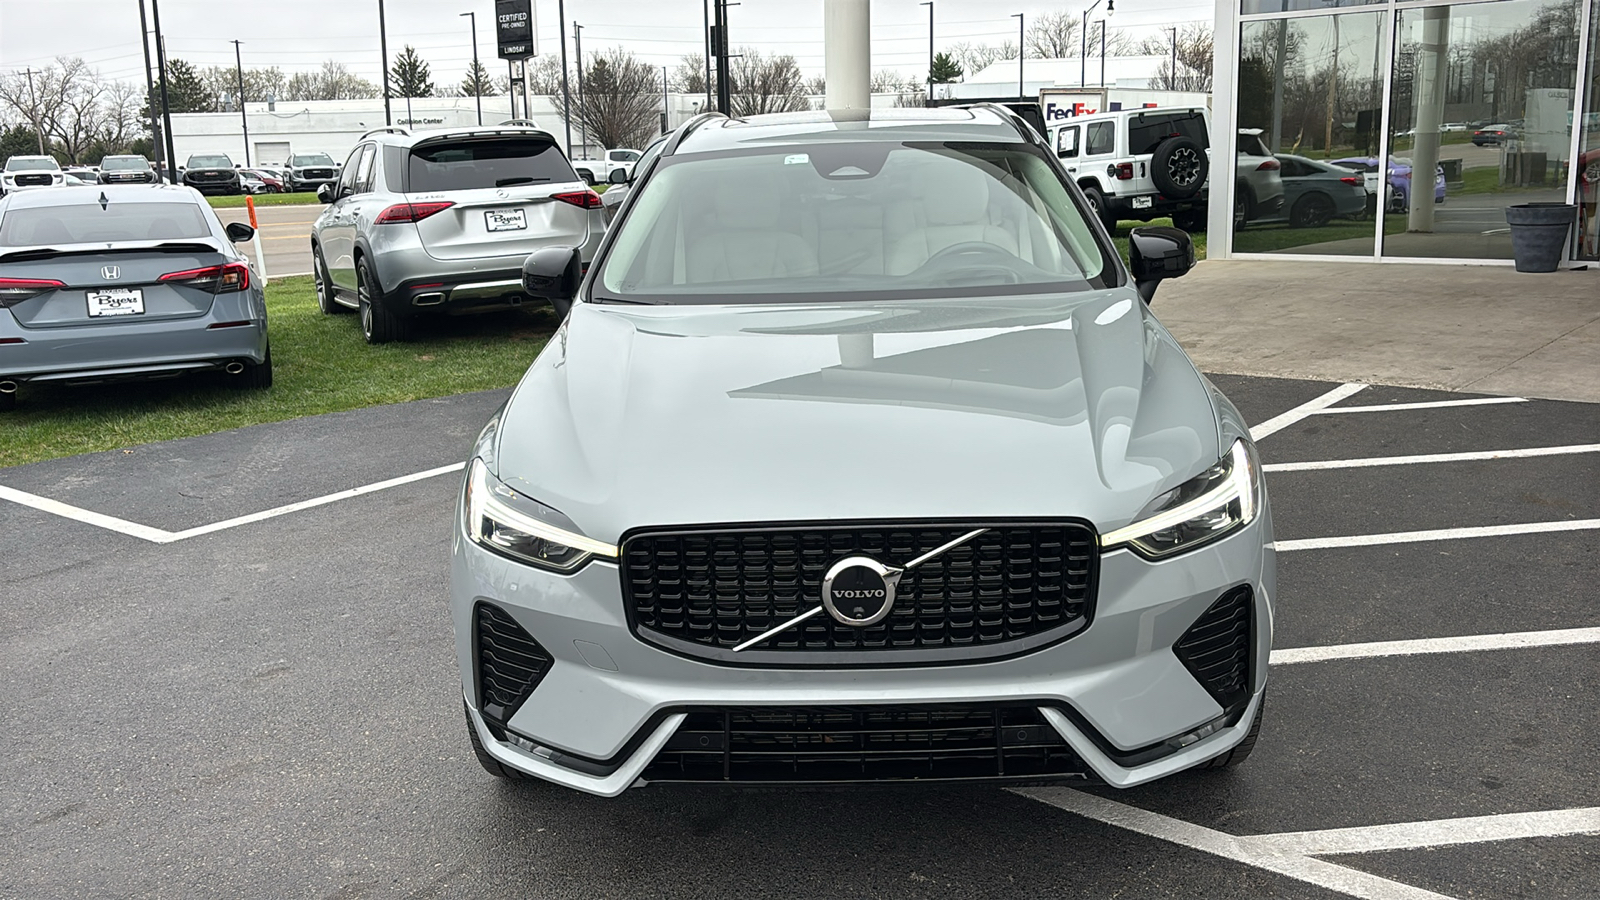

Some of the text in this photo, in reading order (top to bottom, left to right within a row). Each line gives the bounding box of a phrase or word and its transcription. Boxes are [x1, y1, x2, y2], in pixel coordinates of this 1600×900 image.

[499, 12, 527, 22] CERTIFIED
[504, 46, 526, 54] LINDSAY
[92, 295, 138, 308] Byers
[832, 590, 884, 598] VOLVO
